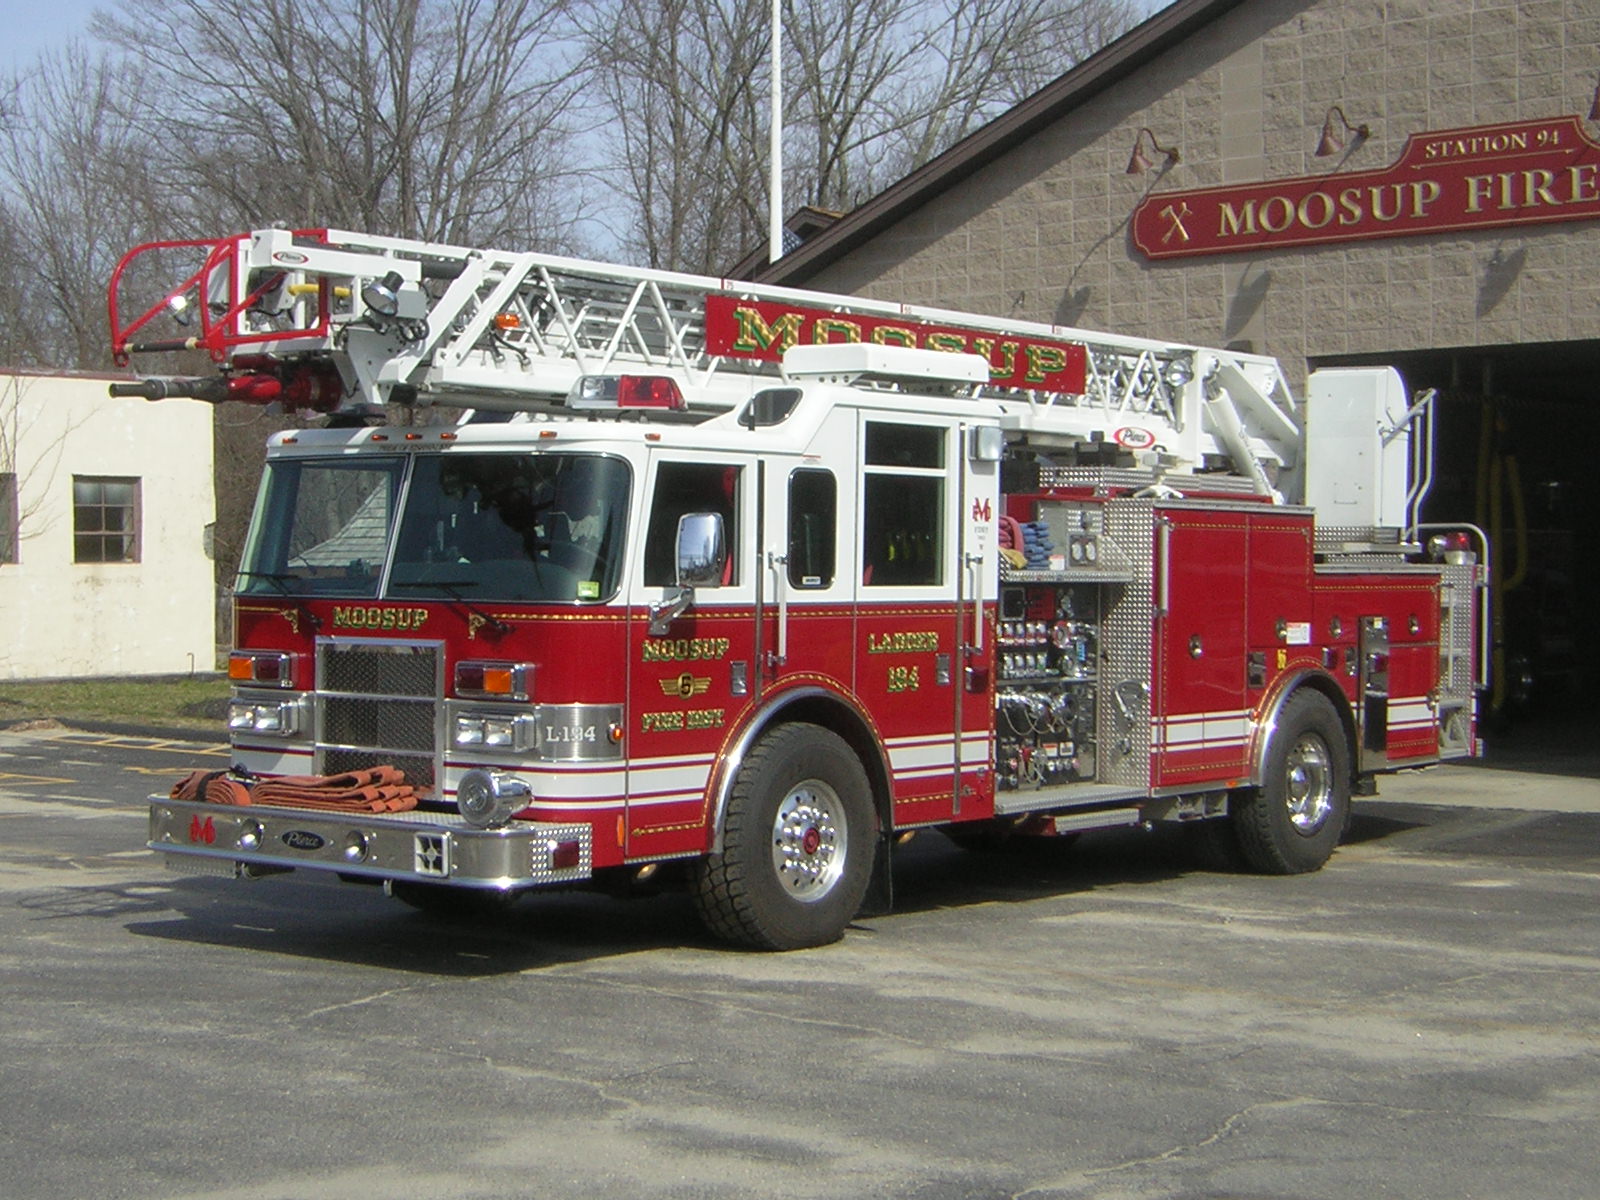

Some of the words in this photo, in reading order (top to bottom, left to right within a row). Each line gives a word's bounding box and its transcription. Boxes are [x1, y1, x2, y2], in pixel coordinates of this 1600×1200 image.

[1425, 132, 1527, 159] STATION
[1537, 129, 1560, 146] 94
[1216, 180, 1441, 237] MOOSUP
[1464, 164, 1600, 213] FIRE
[332, 606, 429, 630] MOOSUP
[642, 637, 730, 662] MOOSUP
[868, 631, 939, 654] LADDER
[641, 711, 685, 733] FIRE
